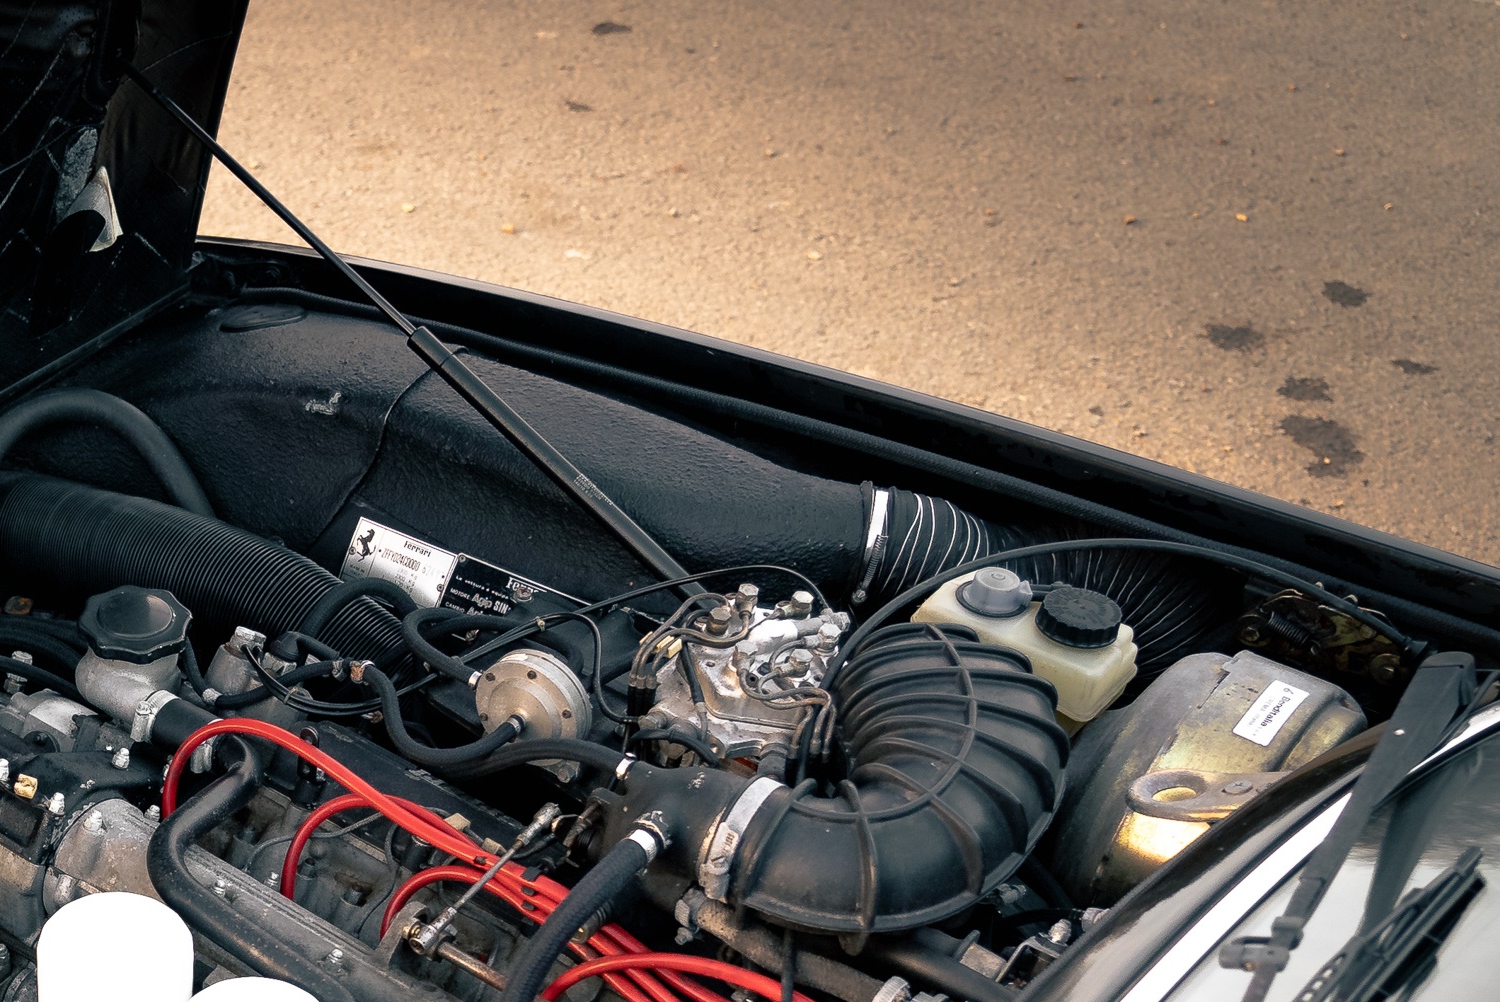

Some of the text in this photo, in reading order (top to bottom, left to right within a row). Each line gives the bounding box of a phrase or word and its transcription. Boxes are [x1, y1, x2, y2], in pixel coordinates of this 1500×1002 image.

[404, 541, 431, 557] Ferrari
[450, 588, 512, 614] MOTORE Agip SIN
